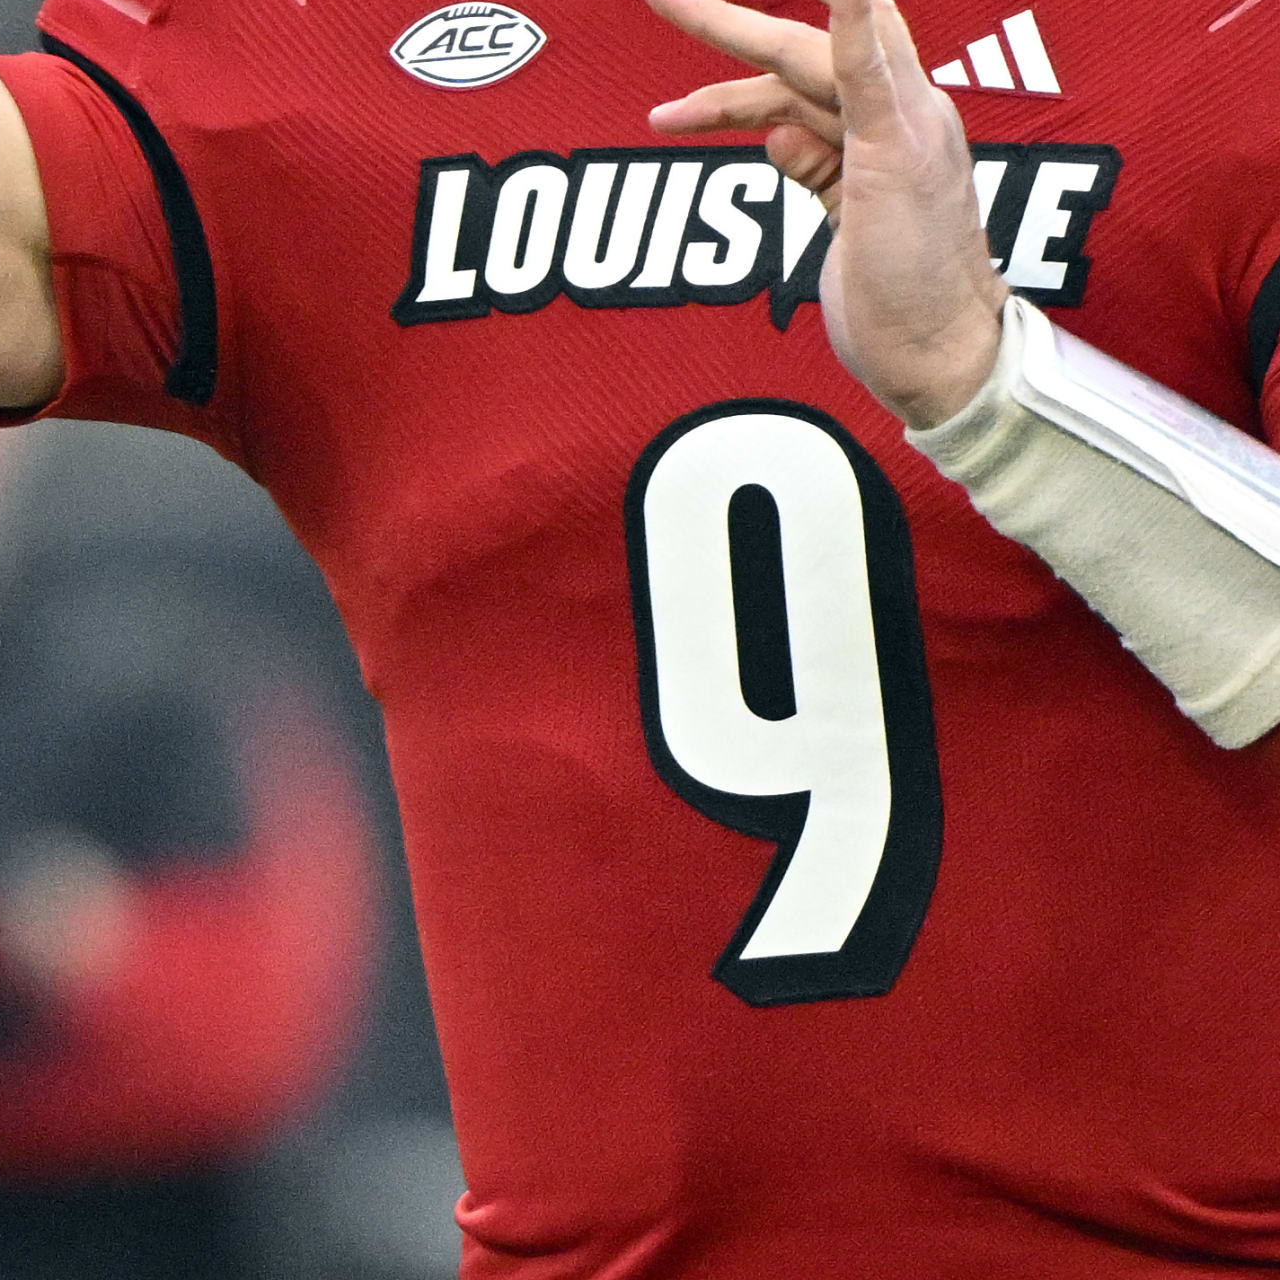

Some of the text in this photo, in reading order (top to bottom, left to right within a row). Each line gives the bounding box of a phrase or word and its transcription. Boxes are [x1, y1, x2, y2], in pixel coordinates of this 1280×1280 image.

[417, 22, 520, 57] ACC
[407, 153, 1108, 312] LOUISVE
[634, 405, 915, 980] 9
